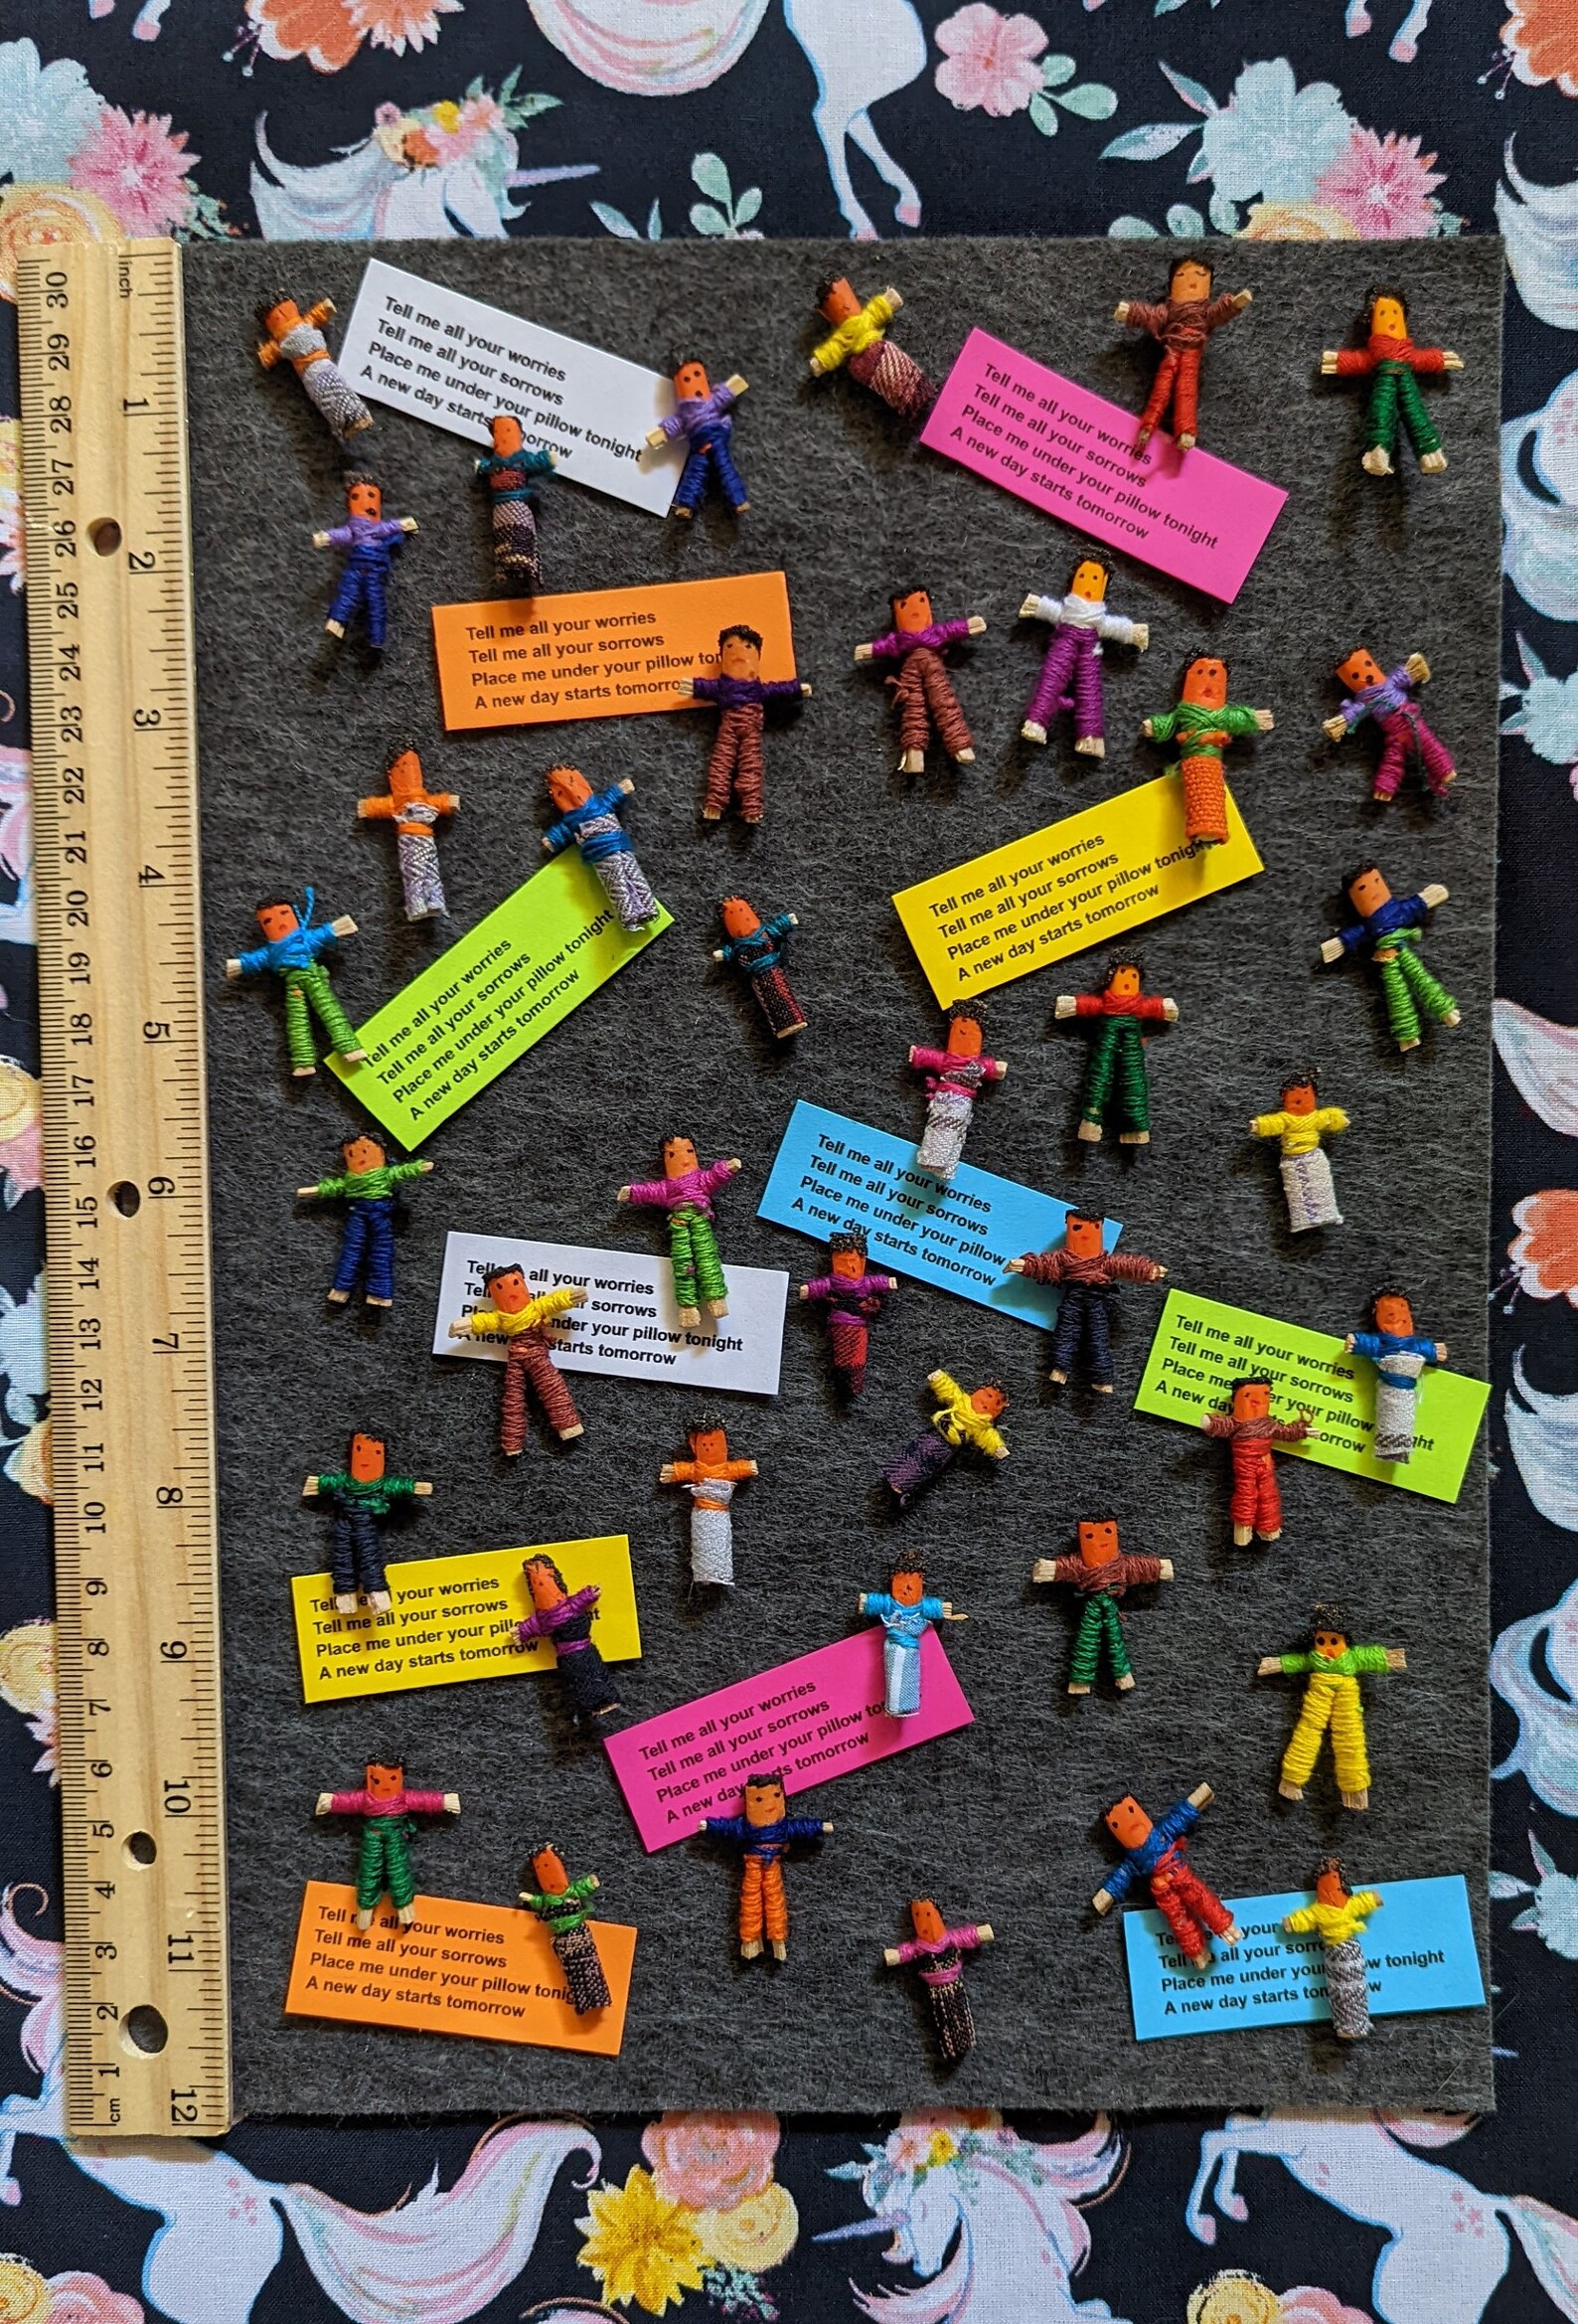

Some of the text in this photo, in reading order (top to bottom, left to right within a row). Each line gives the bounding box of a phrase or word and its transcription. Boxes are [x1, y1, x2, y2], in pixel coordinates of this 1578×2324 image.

[47, 271, 68, 307] 30
[118, 260, 133, 298] inch
[49, 334, 70, 370] 29
[387, 296, 565, 382] Tell me all your worries
[51, 397, 72, 432] 28
[123, 399, 148, 410] 1
[369, 341, 643, 463] Place me under your pillow tonight
[973, 384, 1147, 488] Tell me all your sorrows
[53, 458, 74, 495] 27
[961, 405, 1217, 552] Place me under your pillow tonight
[56, 521, 77, 557] 26
[129, 552, 155, 570] 2
[58, 582, 79, 618] 25
[465, 611, 656, 641] Tell me all your worries
[61, 645, 80, 680] 24
[62, 707, 82, 743] 23
[134, 709, 160, 727] 3
[65, 767, 84, 803] 22
[66, 831, 85, 864] 21
[138, 865, 165, 883] 4
[927, 834, 1105, 917] Tell me all your worries
[68, 891, 88, 926] 20
[959, 884, 1159, 981] A new day starts tomorrow
[70, 952, 90, 985] 19
[376, 952, 531, 1084] Tell me all your sorrows
[393, 909, 615, 1103] Place me under your pillow tonight
[71, 1013, 91, 1046] 18
[144, 1022, 170, 1039] 5
[73, 1075, 93, 1105] 17
[75, 1135, 95, 1167] 16
[148, 1177, 175, 1194] 6
[818, 1133, 991, 1214] Tell me all your worries
[810, 1154, 988, 1237] Tell me all your sorrows
[77, 1197, 97, 1228] 15
[79, 1258, 98, 1289] 14
[552, 1272, 653, 1295] your worries
[590, 1300, 657, 1318] sorrows
[80, 1318, 100, 1350] 13
[153, 1334, 178, 1349] 7
[591, 1322, 743, 1353] your pillow tonight
[1176, 1314, 1354, 1381] Tell me all your worries
[1170, 1335, 1354, 1404] Tell me all your sorrows
[81, 1380, 102, 1411] 12
[84, 1443, 103, 1471] 11
[157, 1487, 183, 1504] 8
[84, 1502, 105, 1533] 10
[86, 1580, 107, 1595] 9
[312, 1599, 509, 1635] Tell me all your sorrows
[88, 1641, 109, 1656] 8
[161, 1641, 187, 1658] 9
[316, 1624, 485, 1658] Place me under your
[90, 1704, 110, 1716] 7
[638, 1682, 816, 1760] Tell me all your worries
[91, 1763, 112, 1777] 6
[165, 1780, 191, 1813] 10
[93, 1824, 114, 1838] 5
[95, 1884, 115, 1899] 4
[96, 1946, 117, 1959] 3
[168, 1935, 195, 1963] 11
[314, 1928, 507, 1969] Tell me all your sorrows
[1161, 1976, 1205, 1992] Place
[1210, 1973, 1235, 1987] me
[1239, 1966, 1287, 1983] under
[1384, 1949, 1444, 1968] tonight
[98, 2006, 118, 2019] 2
[306, 1975, 526, 2018] A new day starts tomorrow
[1165, 1988, 1299, 2015] A new day starts
[100, 2067, 120, 2077] 1
[110, 2098, 120, 2122] cm
[171, 2089, 198, 2121] 12
